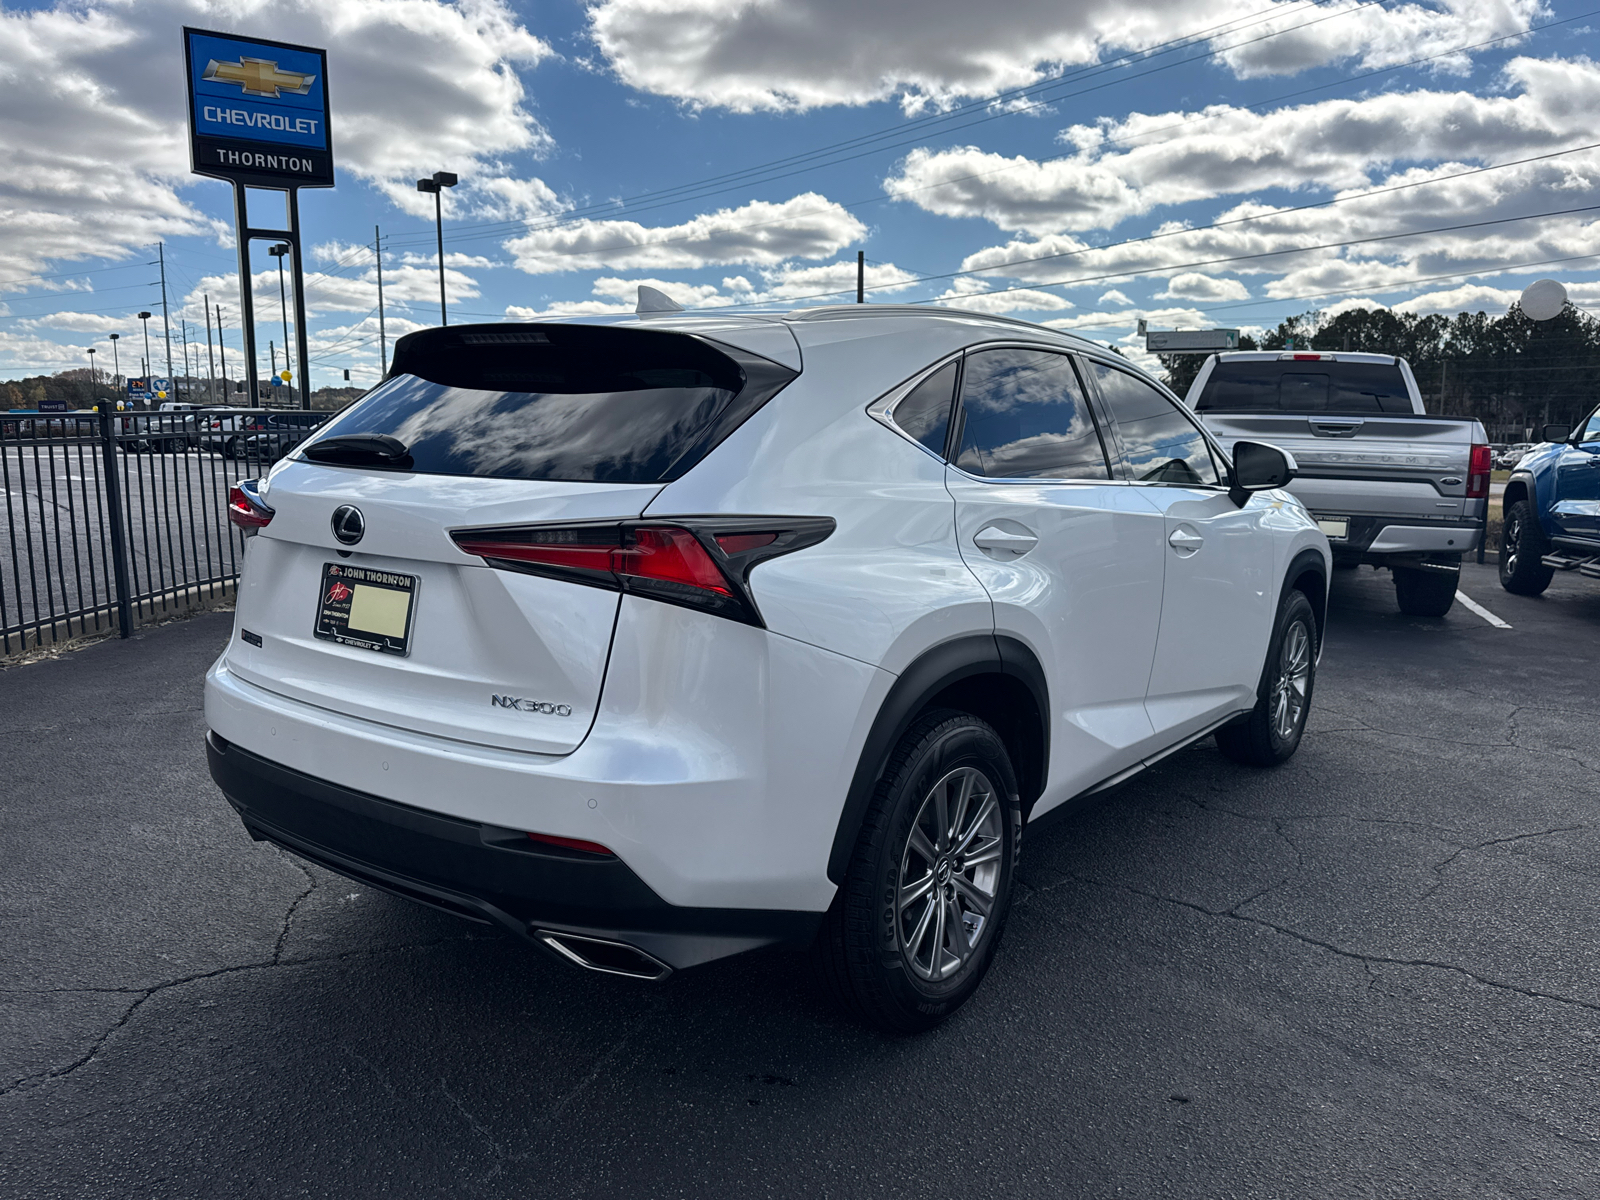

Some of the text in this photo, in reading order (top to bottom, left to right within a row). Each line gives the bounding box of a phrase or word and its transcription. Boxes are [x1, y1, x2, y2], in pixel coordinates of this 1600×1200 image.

[203, 105, 318, 135] CHEVROLET
[217, 148, 313, 173] THORNTON
[343, 567, 411, 587] JOHN THORNTON
[344, 638, 371, 649] CHEVROLET
